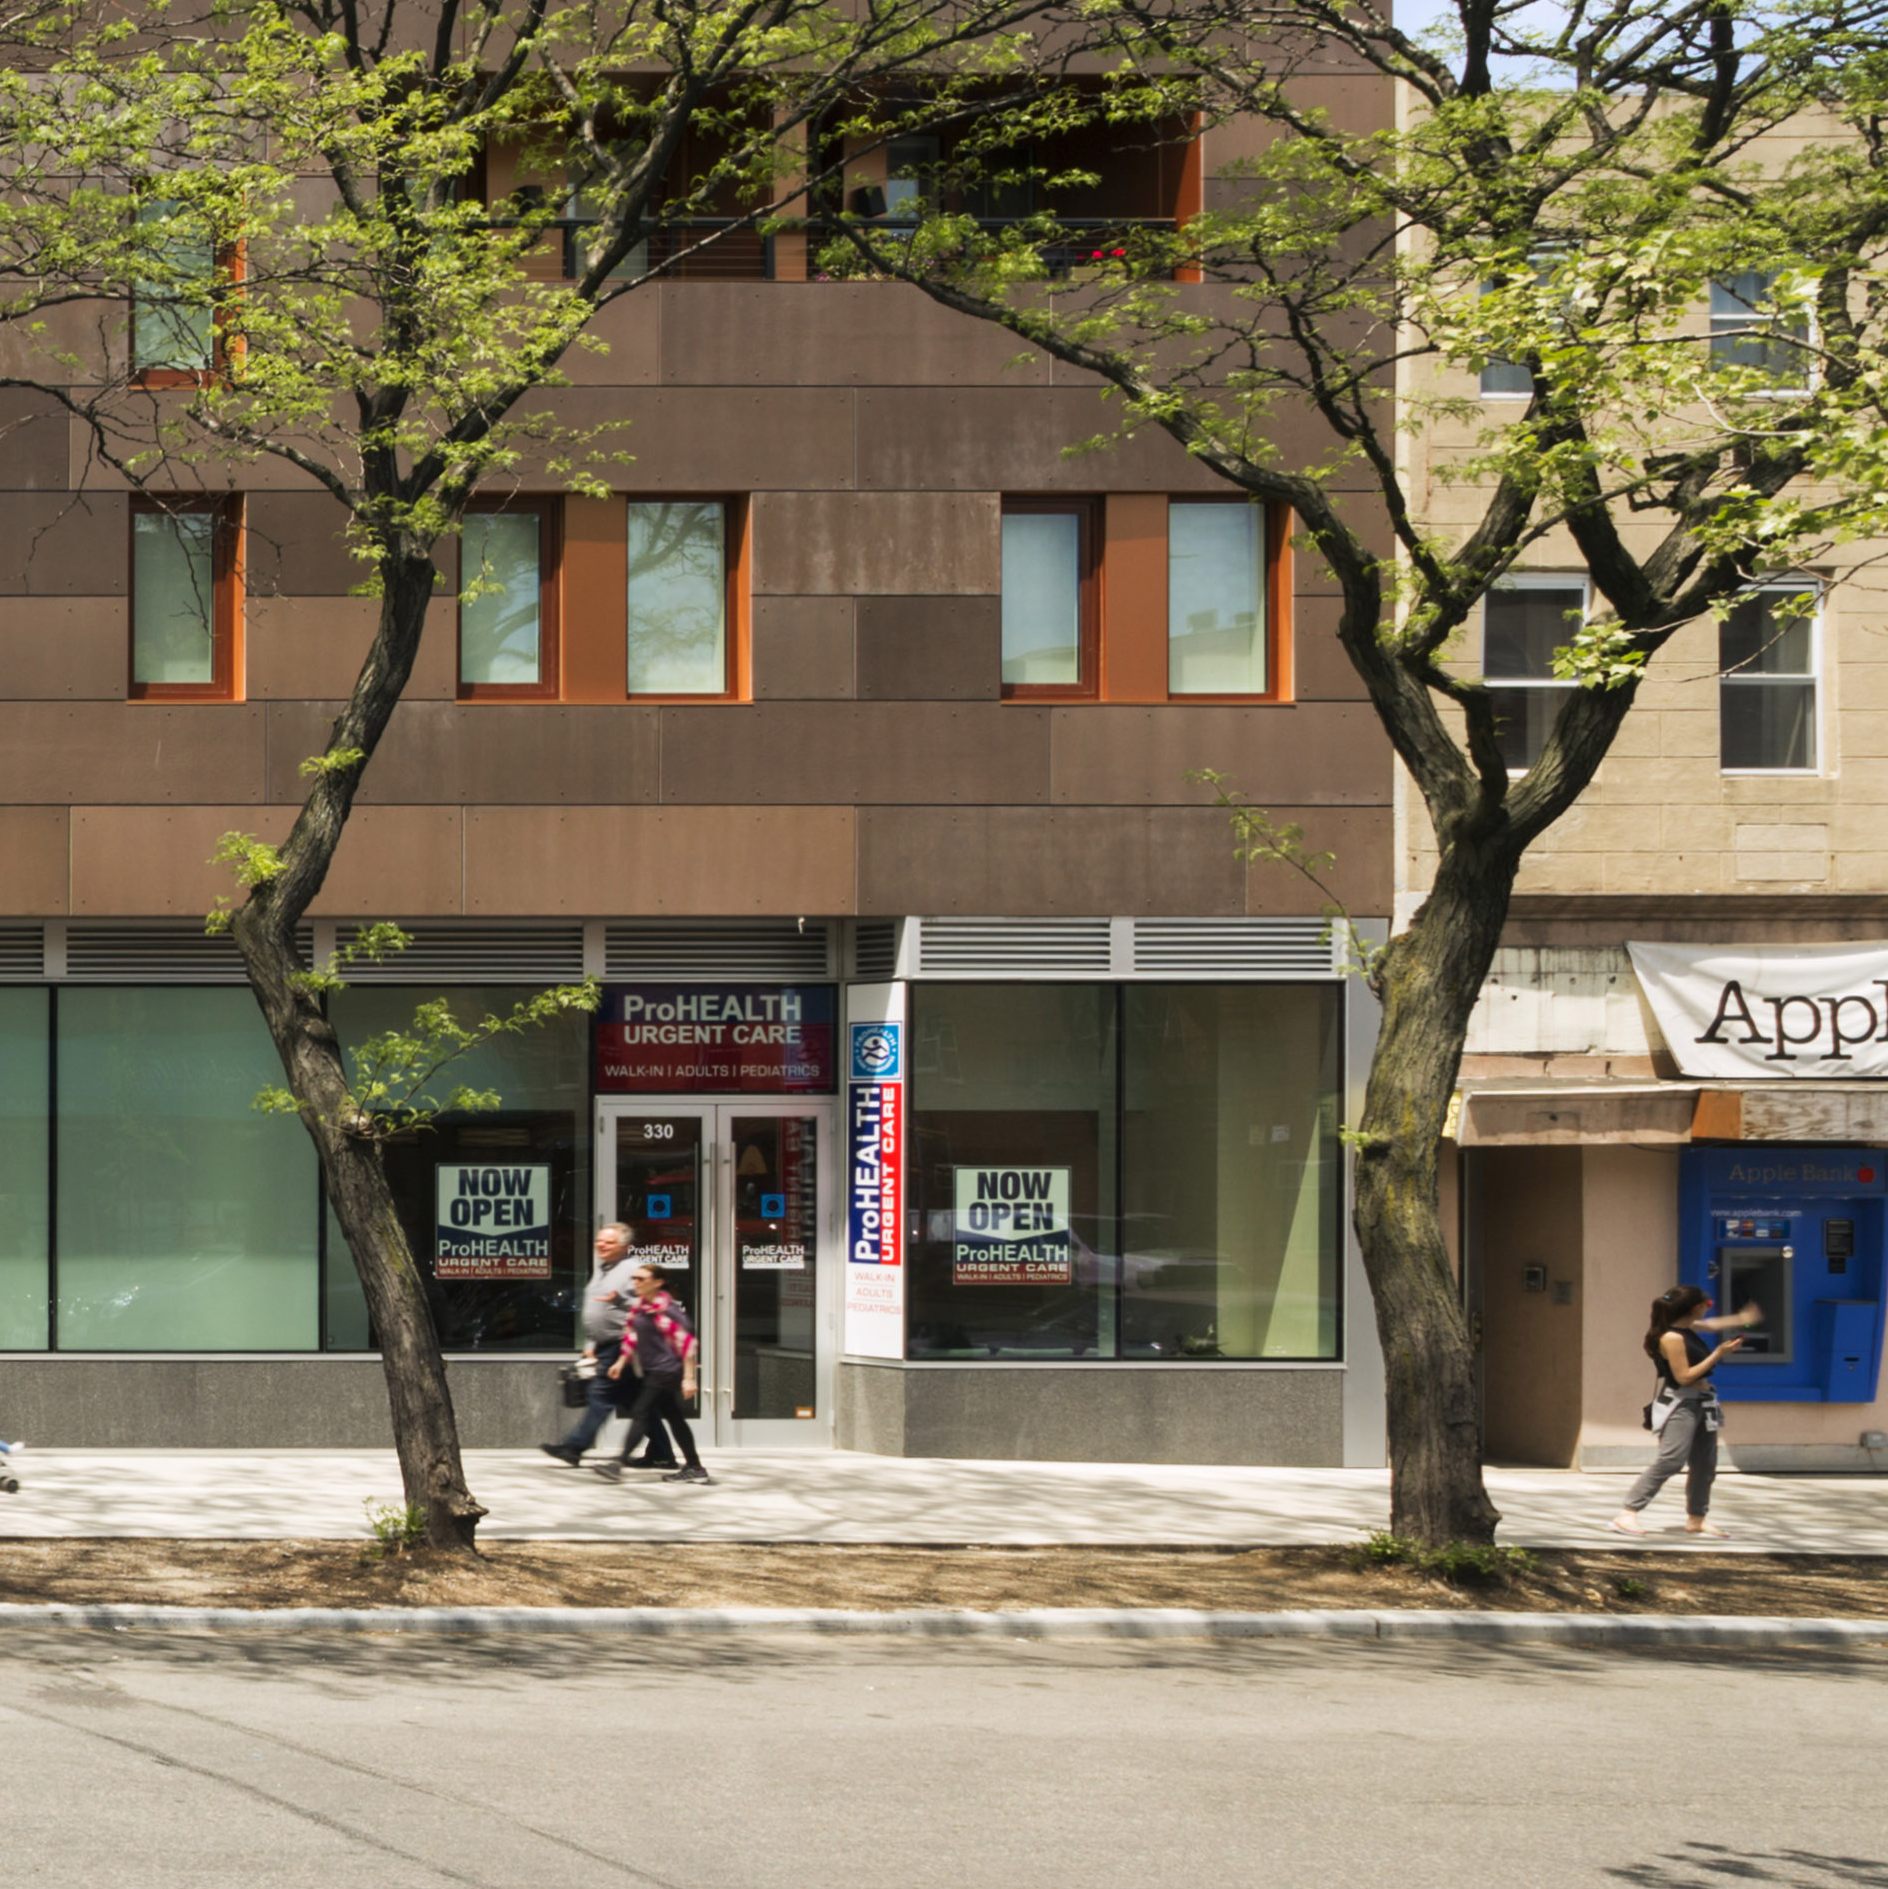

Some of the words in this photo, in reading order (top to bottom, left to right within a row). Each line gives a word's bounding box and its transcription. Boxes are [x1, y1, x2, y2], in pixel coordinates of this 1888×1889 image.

[624, 995, 801, 1021] ProHEALTH
[624, 1025, 726, 1044] URGENT
[732, 1025, 801, 1044] CARE
[604, 1065, 664, 1077] WALK-IN
[675, 1065, 729, 1077] ADULTS
[740, 1065, 820, 1077] PEDIATRICS
[882, 1087, 895, 1154] CARE
[643, 1124, 674, 1139] 330
[458, 1168, 533, 1196] NOW
[855, 1087, 880, 1261] ProHEALTH
[1729, 1163, 1797, 1185] Apple
[1802, 1163, 1855, 1181] Bank
[977, 1171, 1052, 1200] NOW
[450, 1198, 534, 1227] OPEN
[881, 1162, 895, 1261] URGENT
[968, 1202, 1054, 1231] OPEN
[1710, 1209, 1802, 1218] www.applebank.com
[438, 1240, 548, 1257] ProHEALTH
[627, 1245, 689, 1255] ProHEALTH
[742, 1245, 804, 1255] ProHEALTH
[956, 1245, 1068, 1262] ProHEALTH
[438, 1258, 501, 1267] URGENT
[506, 1258, 548, 1267] CARE
[779, 1255, 804, 1263] CARE
[956, 1263, 1020, 1272] URGENT
[1025, 1263, 1068, 1272] CARE
[854, 1272, 895, 1282] WALK-IN
[855, 1287, 893, 1298] ADULTS
